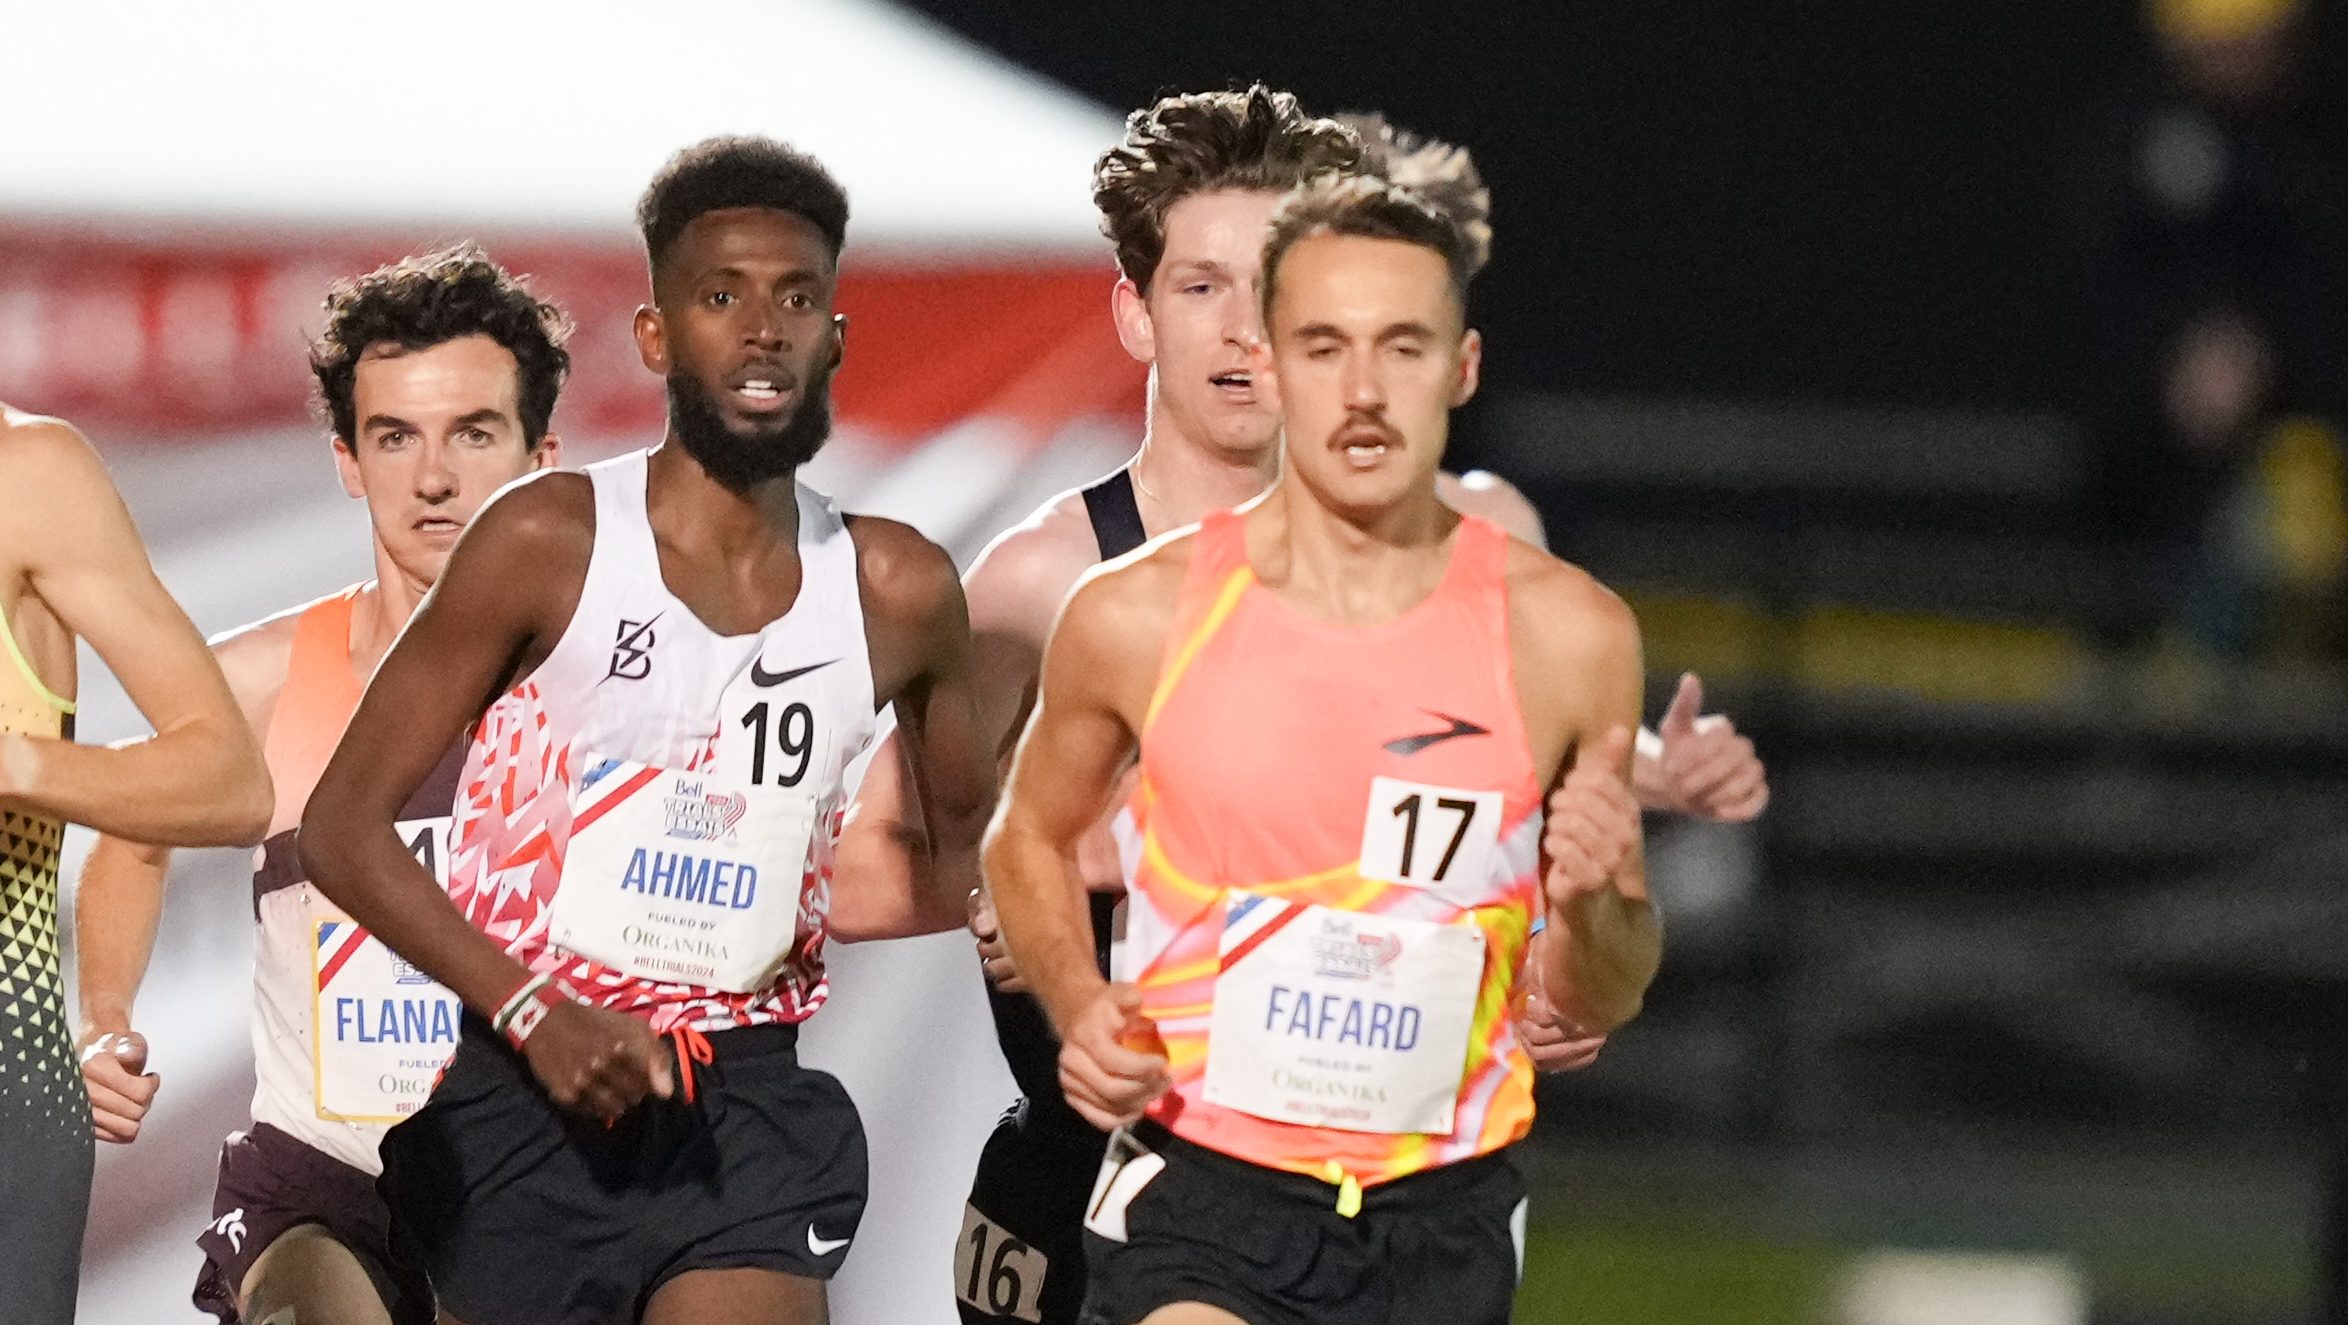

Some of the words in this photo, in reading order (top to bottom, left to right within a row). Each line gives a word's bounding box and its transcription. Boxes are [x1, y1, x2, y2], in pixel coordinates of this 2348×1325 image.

[741, 702, 814, 788] 19
[675, 778, 703, 797] Bell
[1392, 794, 1477, 882] 17
[621, 848, 758, 910] AHMED
[622, 924, 729, 960] ORGANIKA
[647, 911, 697, 928] FUELED
[700, 920, 717, 931] BY
[336, 997, 462, 1044] FLANA
[1266, 986, 1422, 1053] FAFARD
[379, 1074, 427, 1094] ORG
[399, 1059, 444, 1069] FUELE
[966, 1222, 1028, 1317] 16
